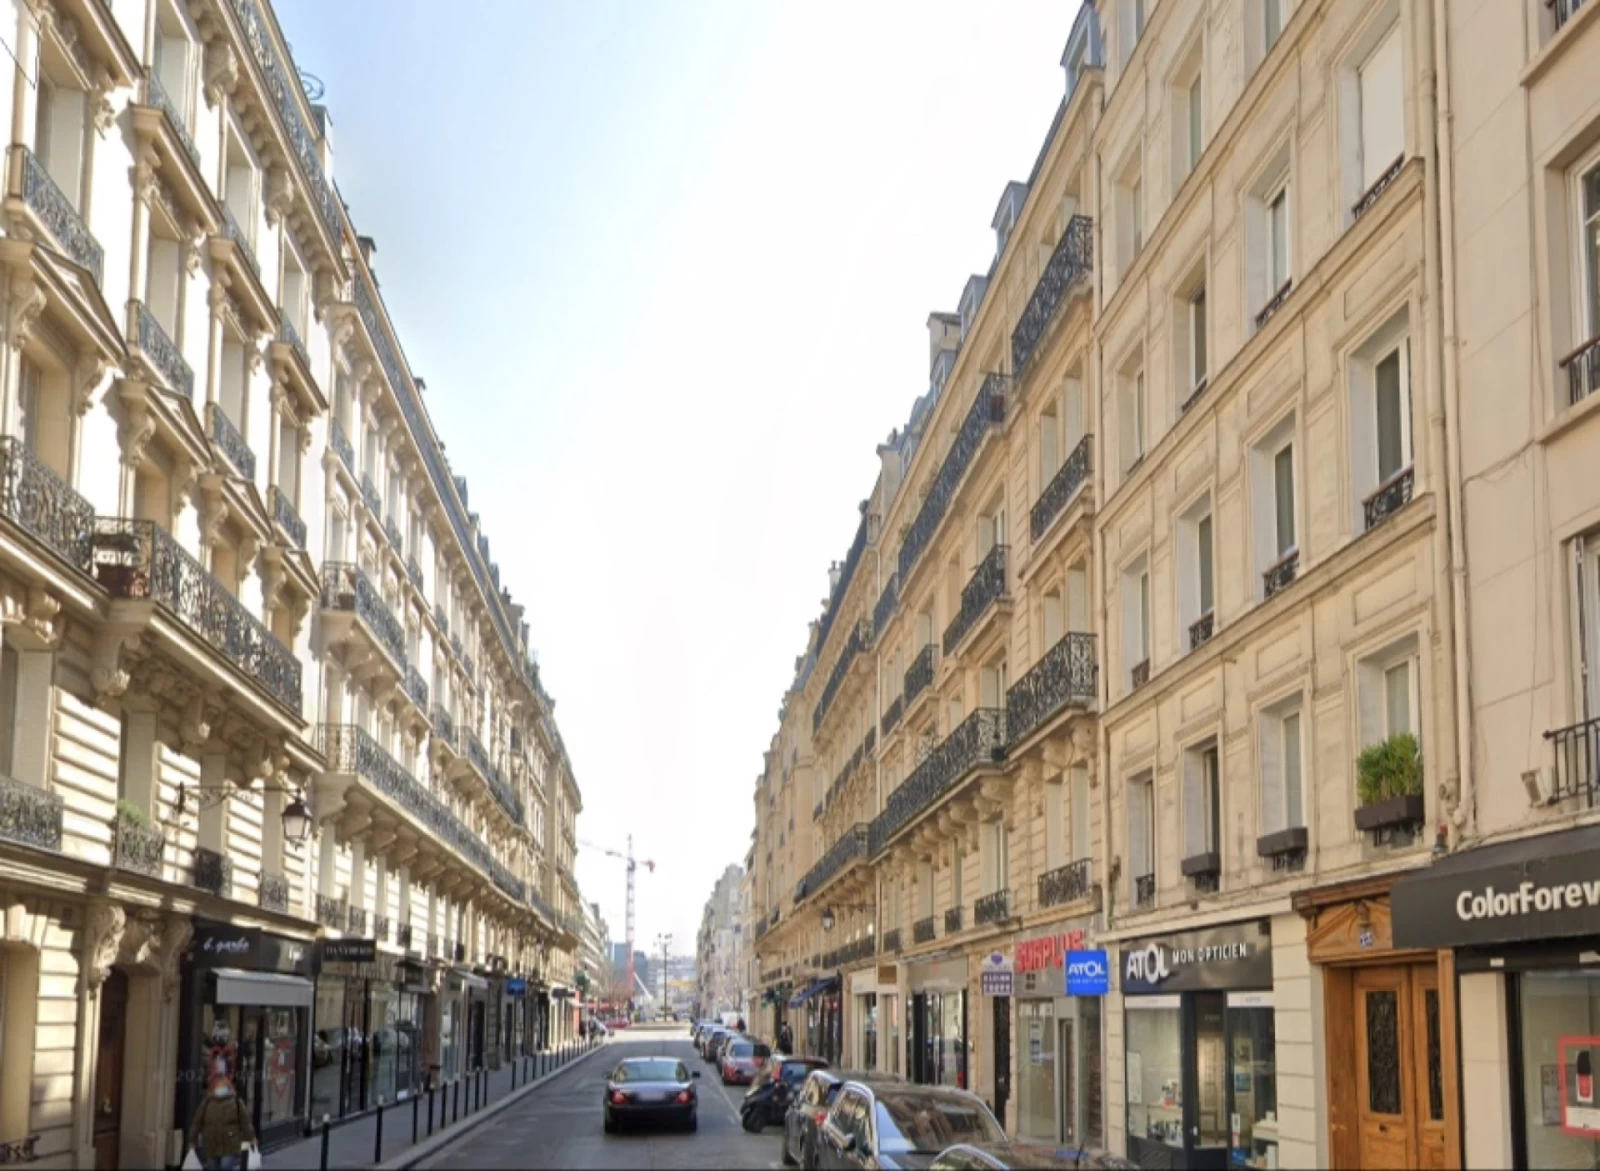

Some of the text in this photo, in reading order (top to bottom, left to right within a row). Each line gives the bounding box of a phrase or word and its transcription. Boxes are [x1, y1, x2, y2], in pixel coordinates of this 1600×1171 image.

[1456, 881, 1600, 920] ColorForev
[1068, 960, 1105, 977] ATOL
[1126, 941, 1248, 984] ATOL MON OPTICIEN
